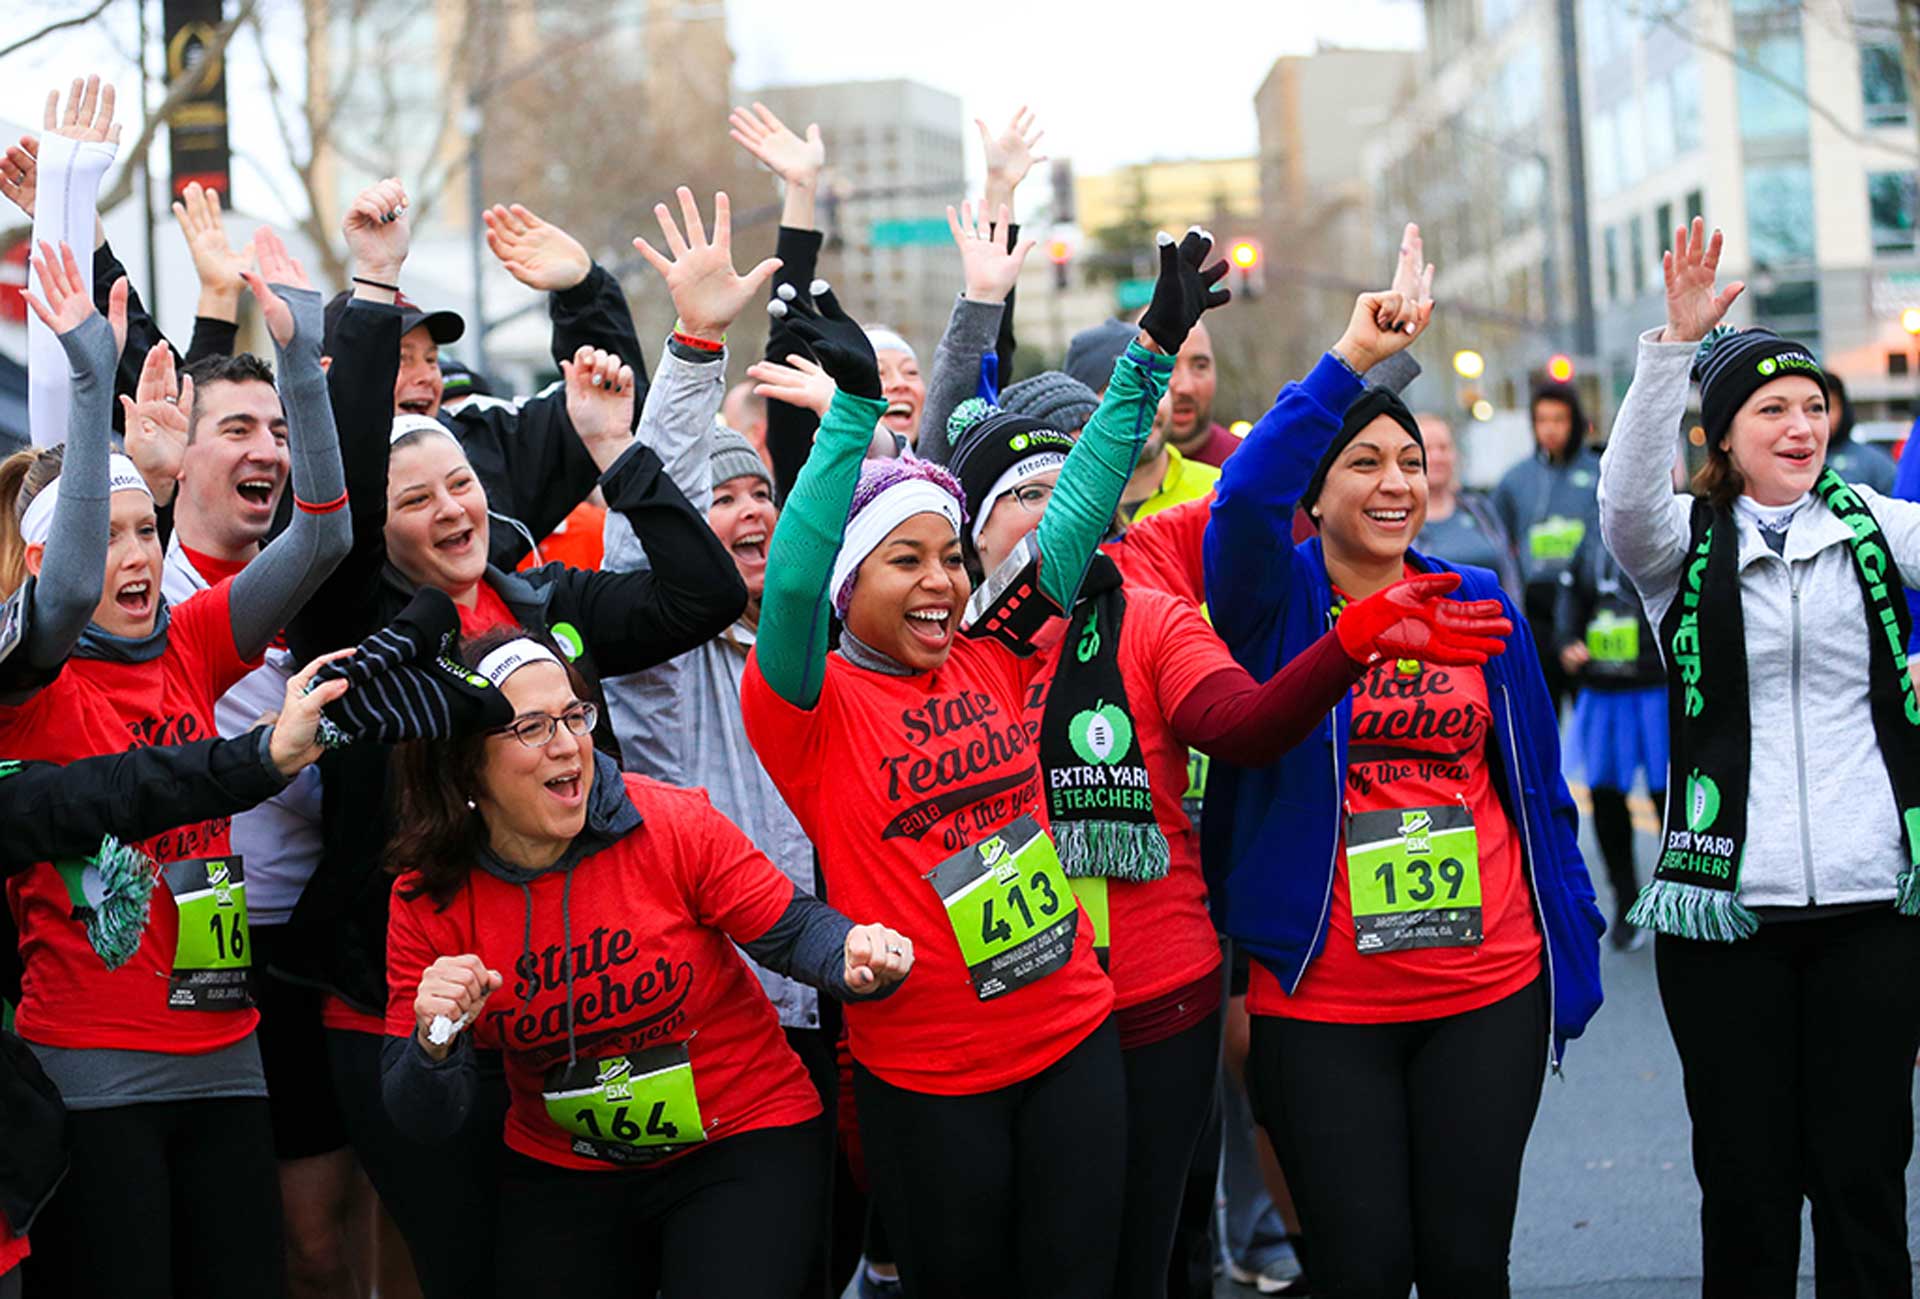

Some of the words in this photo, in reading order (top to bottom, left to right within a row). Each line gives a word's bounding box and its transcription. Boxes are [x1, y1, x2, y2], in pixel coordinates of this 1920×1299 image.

[902, 690, 998, 747] State
[1351, 699, 1476, 740] acher
[1050, 766, 1108, 789] EXTRA
[1377, 763, 1414, 785] the
[971, 800, 1007, 832] the
[1063, 789, 1153, 812] TEACHERS
[900, 803, 943, 835] 2018
[1406, 838, 1429, 851] 5K
[1693, 833, 1734, 857] YARD
[1374, 857, 1465, 905] 139
[981, 871, 1059, 945] 413
[514, 927, 639, 1001] State
[485, 956, 677, 1045] Teacher
[605, 1083, 631, 1100] 5K
[575, 1101, 679, 1142] 164
